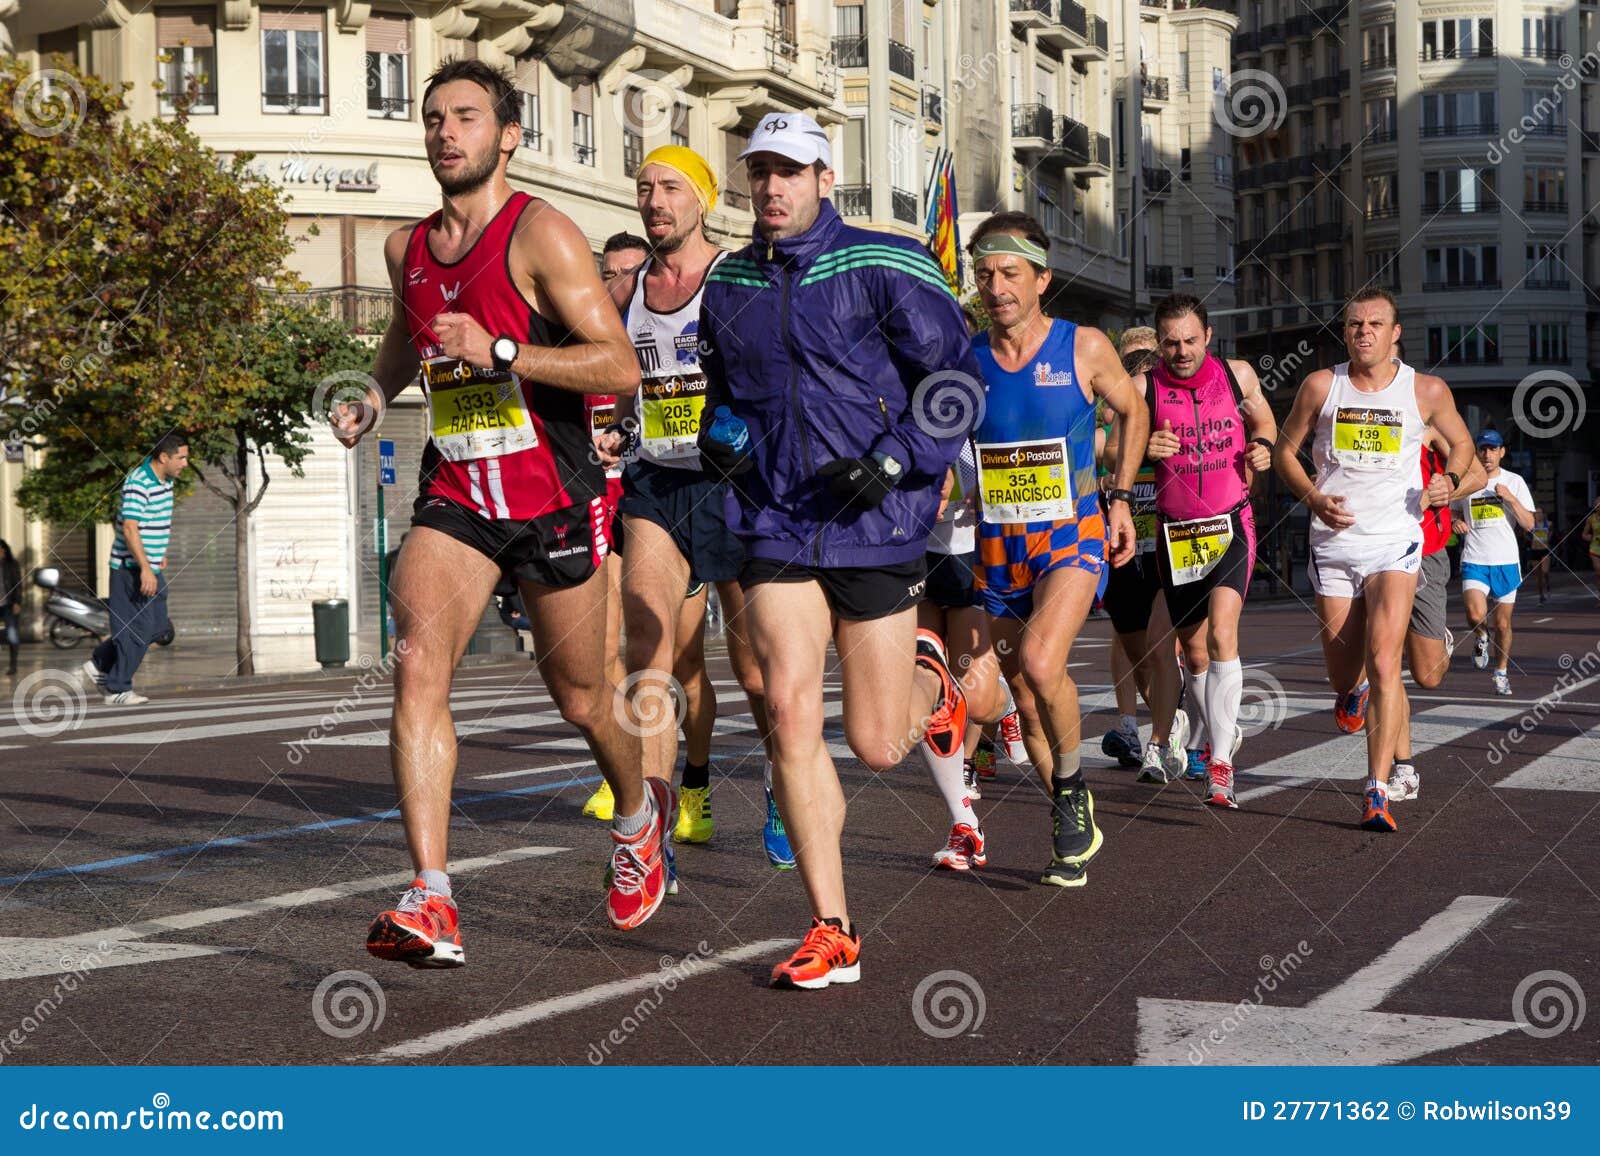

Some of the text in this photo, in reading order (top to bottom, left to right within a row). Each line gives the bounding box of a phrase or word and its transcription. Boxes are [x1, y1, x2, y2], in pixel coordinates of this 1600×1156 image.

[454, 391, 496, 412] 1333
[663, 404, 692, 419] 205
[1338, 412, 1360, 421] Divina
[1374, 413, 1402, 423] Pastora
[451, 409, 506, 433] RAFAEL
[1358, 429, 1380, 440] 139
[1353, 440, 1382, 452] DAVID
[982, 452, 1009, 464] Divina
[1026, 449, 1062, 461] Pastora
[1008, 473, 1037, 487] 354
[989, 485, 1062, 504] FRANCISCO
[1169, 522, 1228, 538] Divina Pastora
[1183, 549, 1219, 568] F.JAIER
